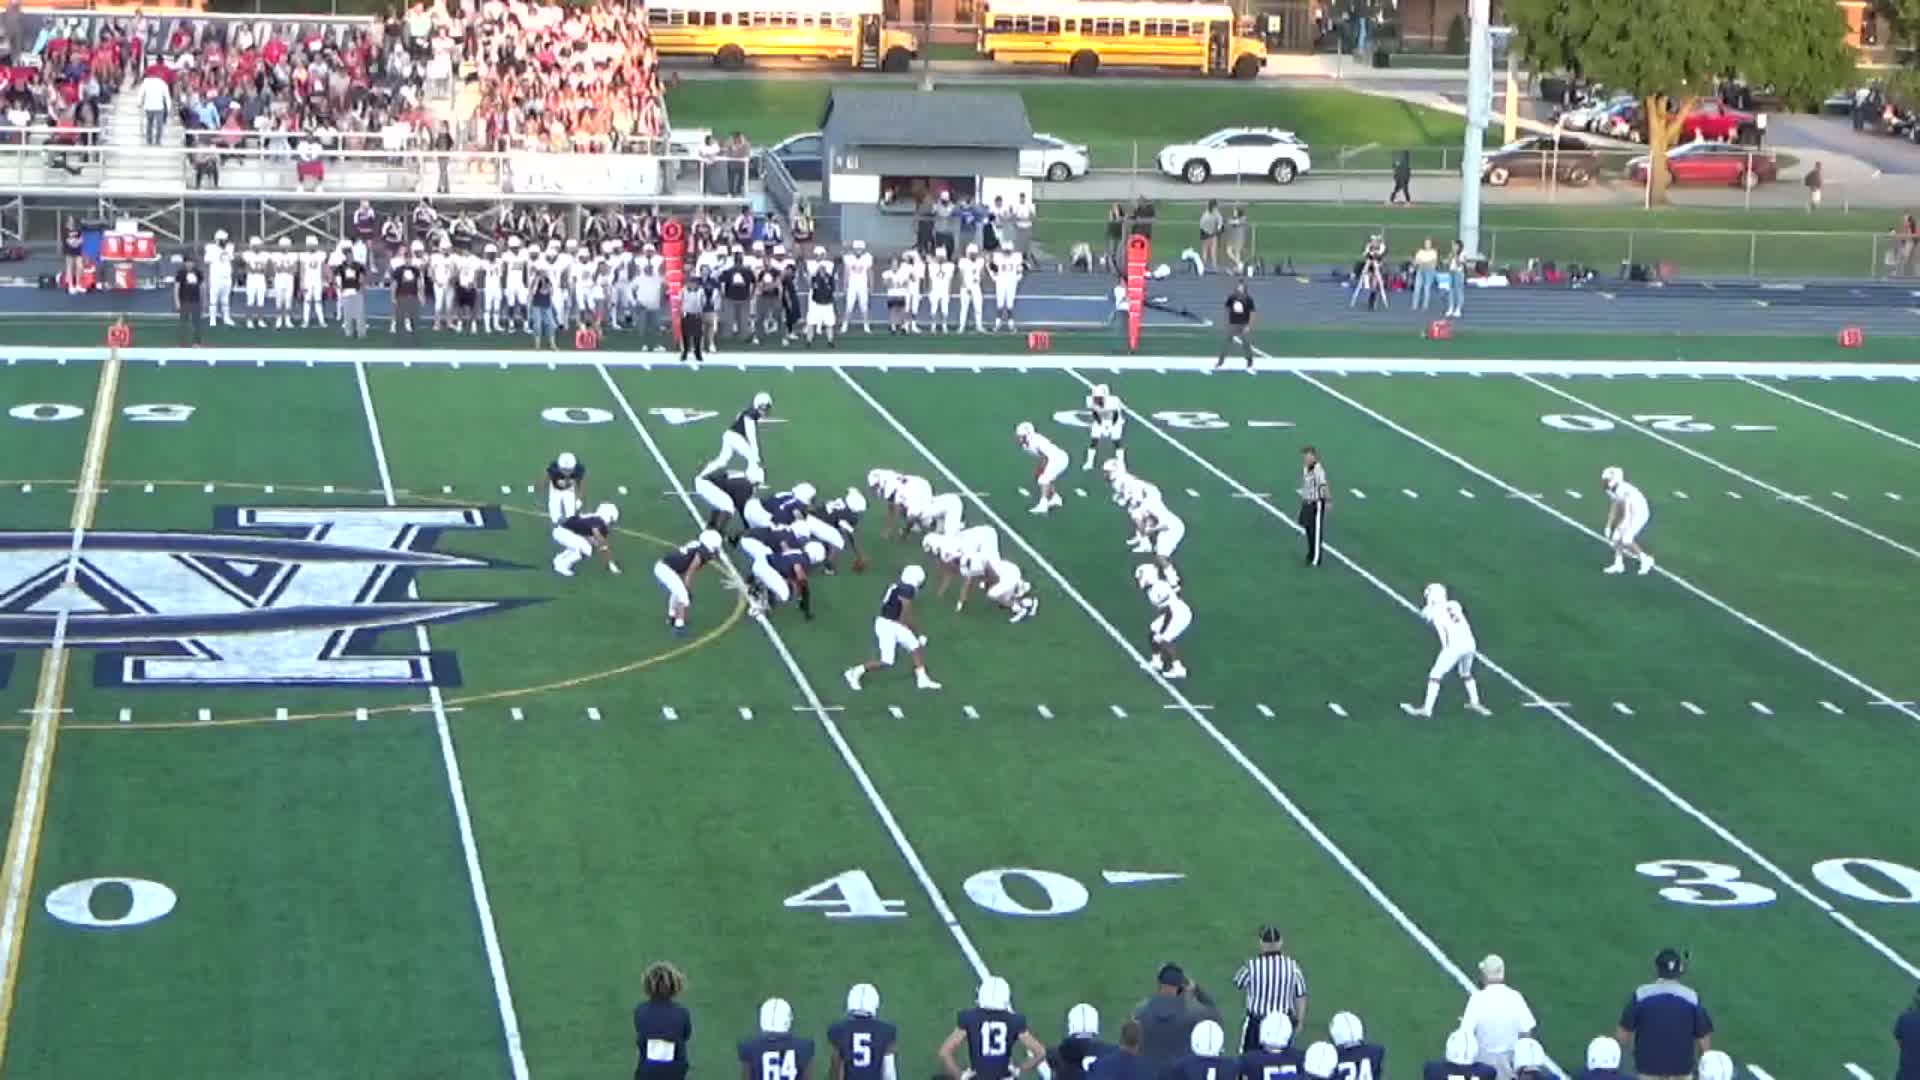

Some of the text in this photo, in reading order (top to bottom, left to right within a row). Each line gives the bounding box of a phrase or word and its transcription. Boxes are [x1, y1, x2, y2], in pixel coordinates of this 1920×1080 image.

[853, 1032, 872, 1067] 5
[980, 1021, 1007, 1056] 13
[762, 1049, 798, 1080] 64
